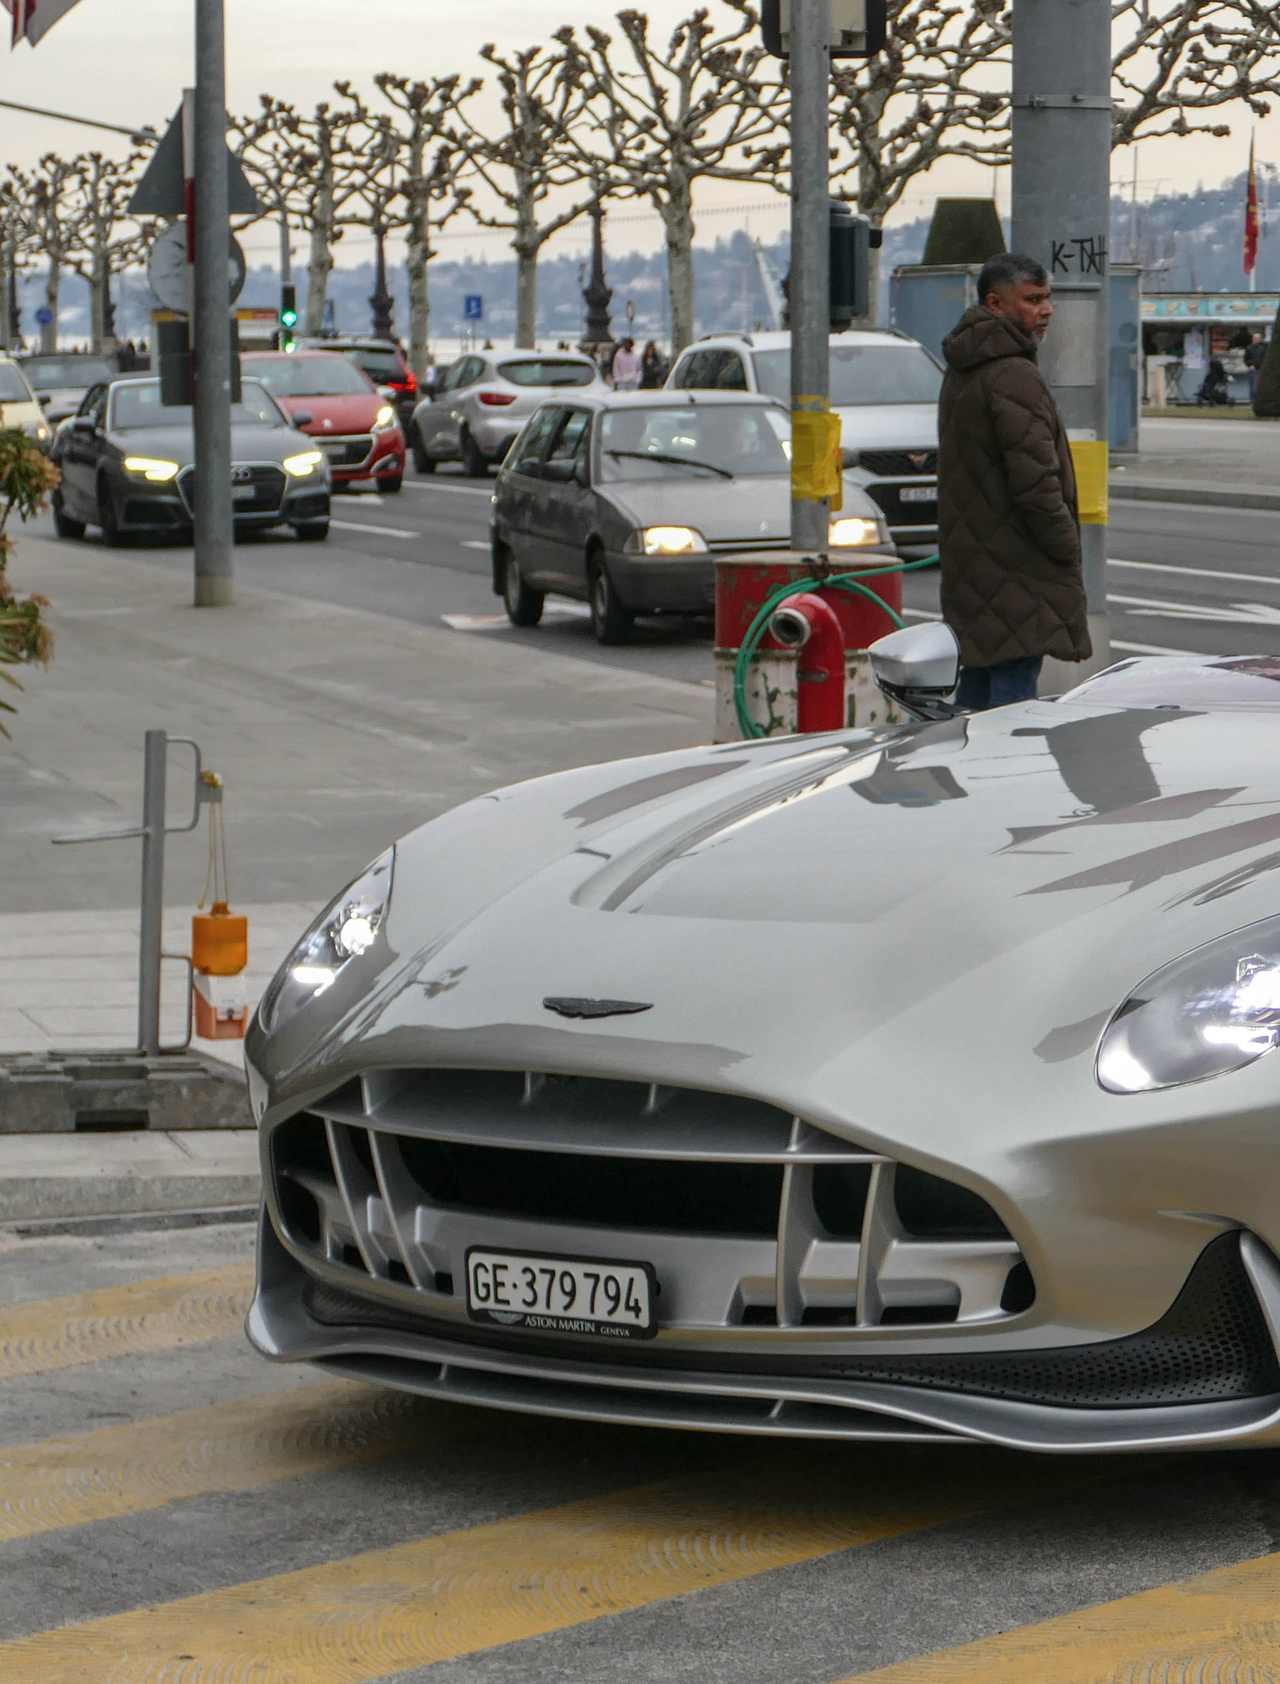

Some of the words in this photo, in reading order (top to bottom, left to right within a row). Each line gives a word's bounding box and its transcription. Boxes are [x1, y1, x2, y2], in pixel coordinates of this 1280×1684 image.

[525, 1315, 557, 1329] ASTON
[559, 1319, 595, 1333] MARTIN
[600, 1326, 630, 1337] GENEVA
